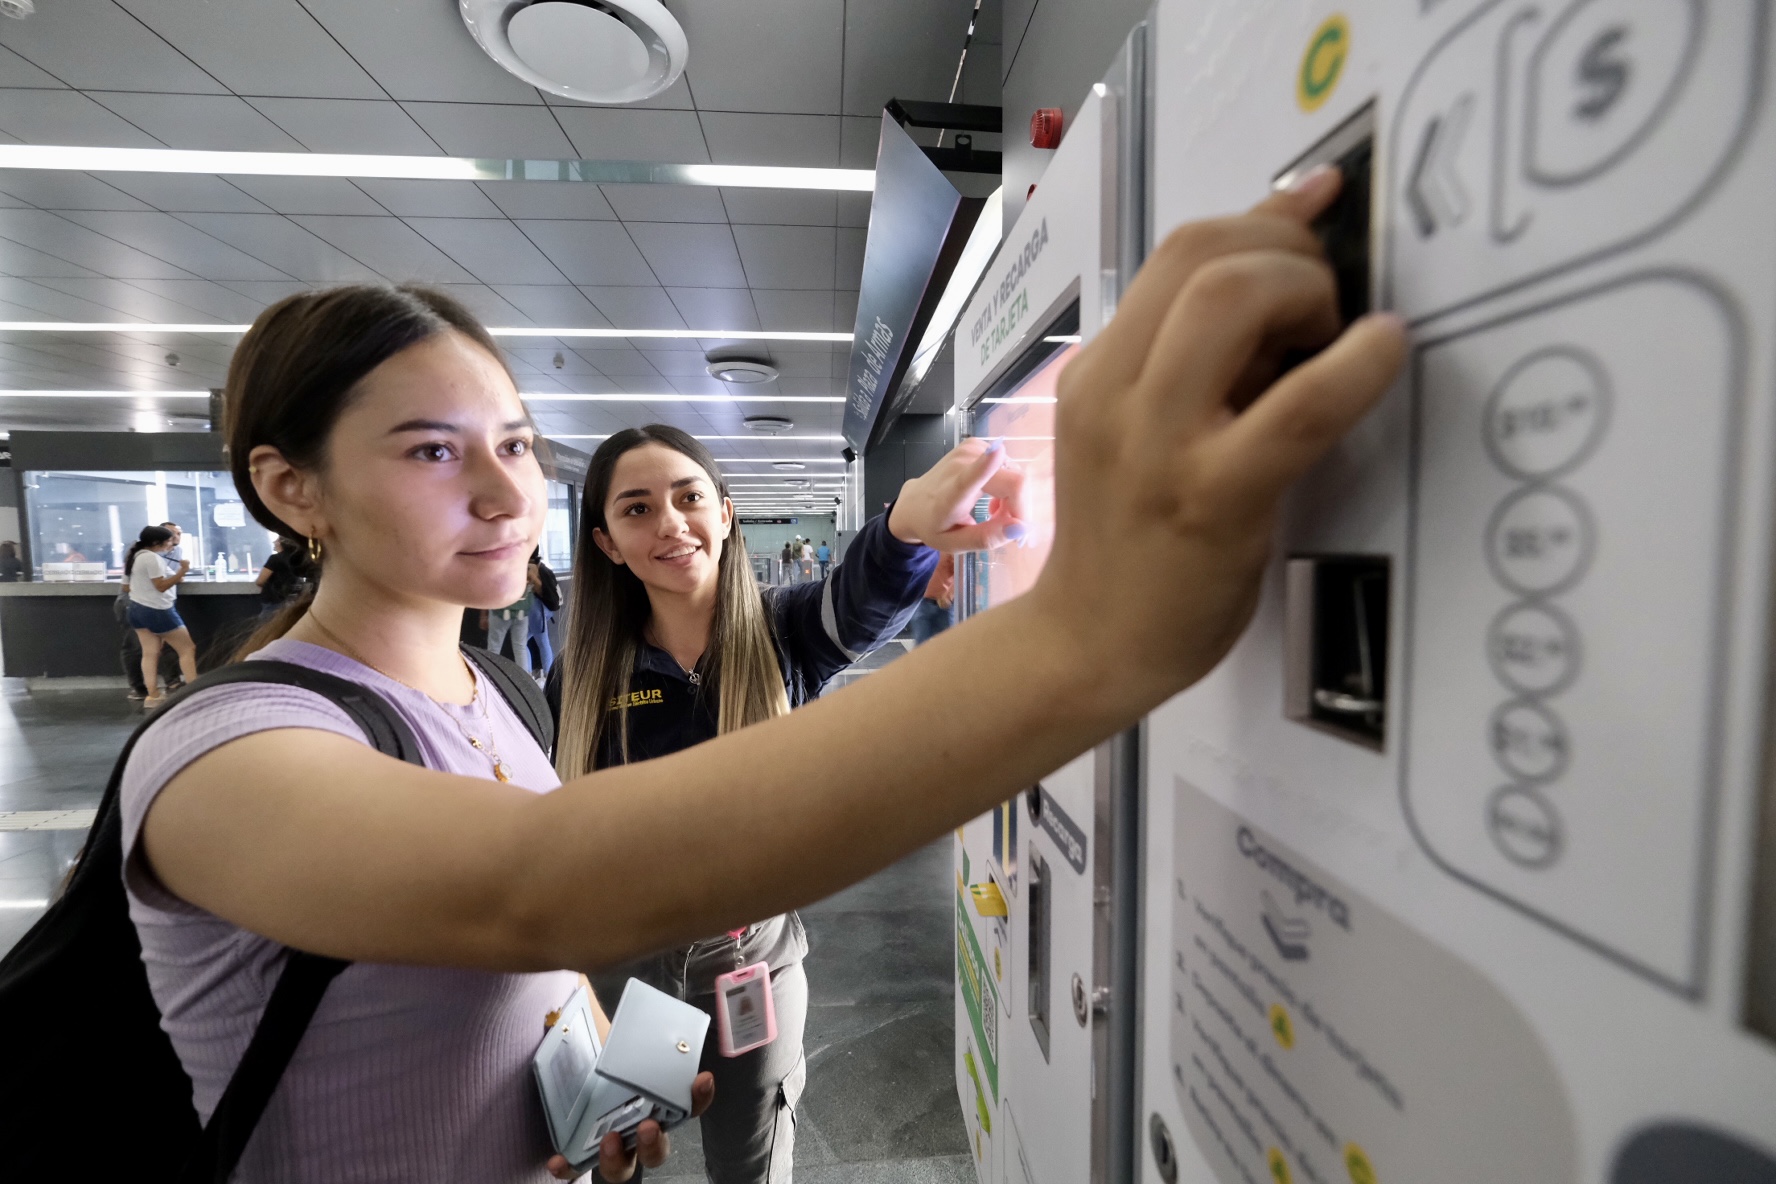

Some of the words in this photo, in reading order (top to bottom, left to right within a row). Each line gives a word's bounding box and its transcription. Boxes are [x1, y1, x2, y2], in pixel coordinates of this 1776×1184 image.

[971, 303, 992, 347] VENTA
[1000, 217, 1049, 308] RECARGA
[864, 316, 893, 365] Armas
[980, 336, 990, 366] DE
[991, 287, 1029, 353] TARJETA
[857, 369, 878, 398] Plaza
[861, 351, 882, 375] de
[852, 392, 871, 421] Salida
[1043, 798, 1084, 864] Recarga
[1237, 826, 1351, 931] Compra
